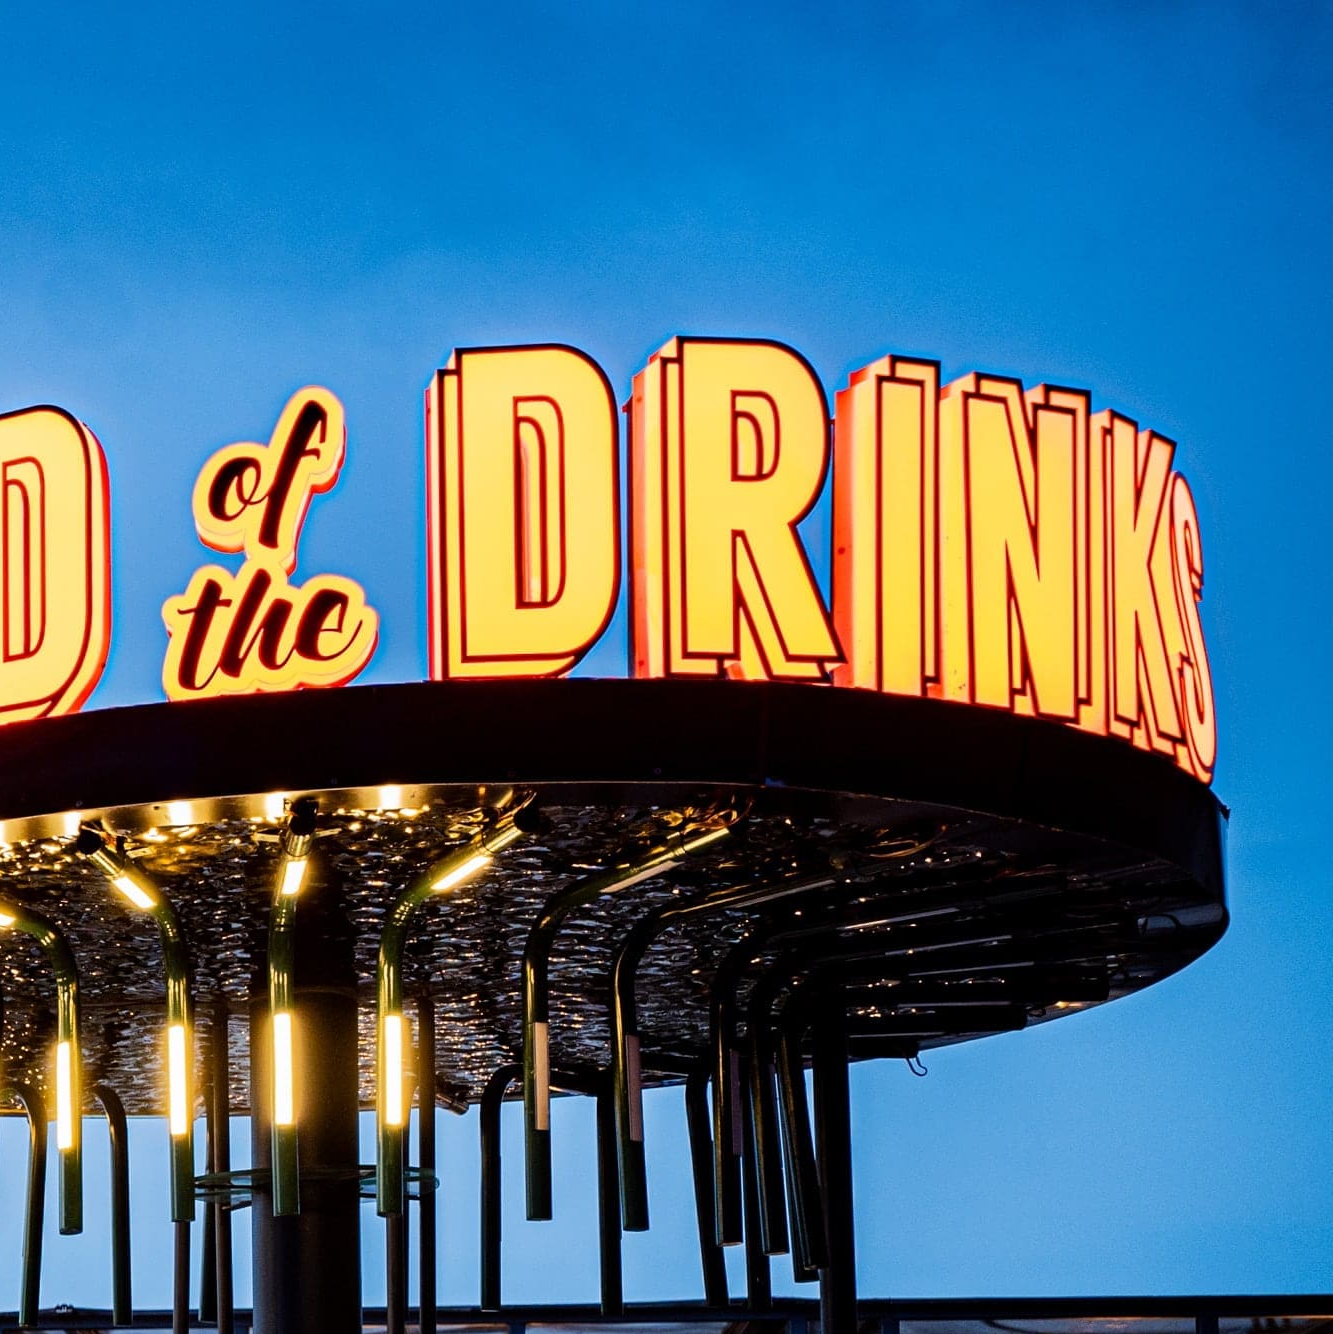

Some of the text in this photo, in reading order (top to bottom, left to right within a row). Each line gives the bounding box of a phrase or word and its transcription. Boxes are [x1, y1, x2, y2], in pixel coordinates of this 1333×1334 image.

[205, 397, 331, 551] of
[174, 566, 365, 692] the
[426, 335, 1217, 784] DRINKS
